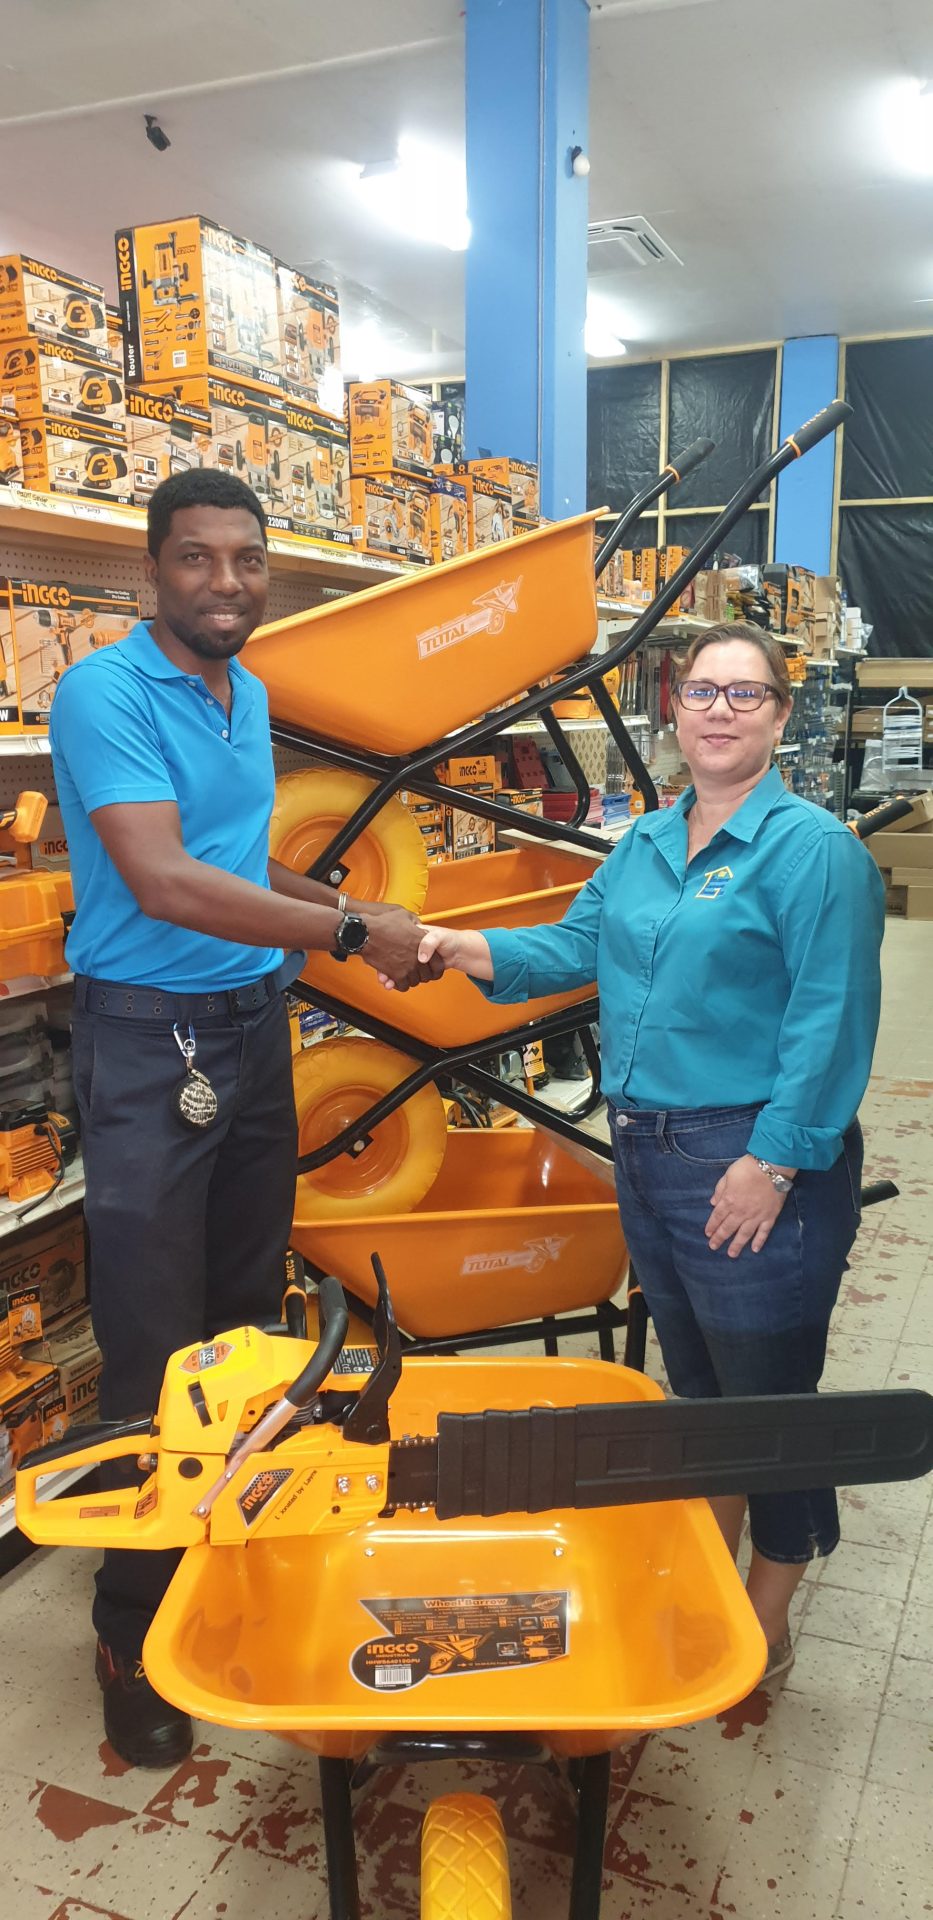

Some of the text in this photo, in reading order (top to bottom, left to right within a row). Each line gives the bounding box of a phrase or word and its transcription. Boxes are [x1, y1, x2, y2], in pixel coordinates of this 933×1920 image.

[128, 344, 136, 376] Router
[258, 370, 280, 386] 2200W
[267, 516, 289, 529] 2200W
[332, 531, 350, 543] 2200W
[22, 583, 70, 606] INGCO
[423, 623, 468, 652] TOTAL
[44, 840, 68, 855] INGC
[464, 1597, 508, 1607] Barrow
[367, 1643, 418, 1654] INGCO
